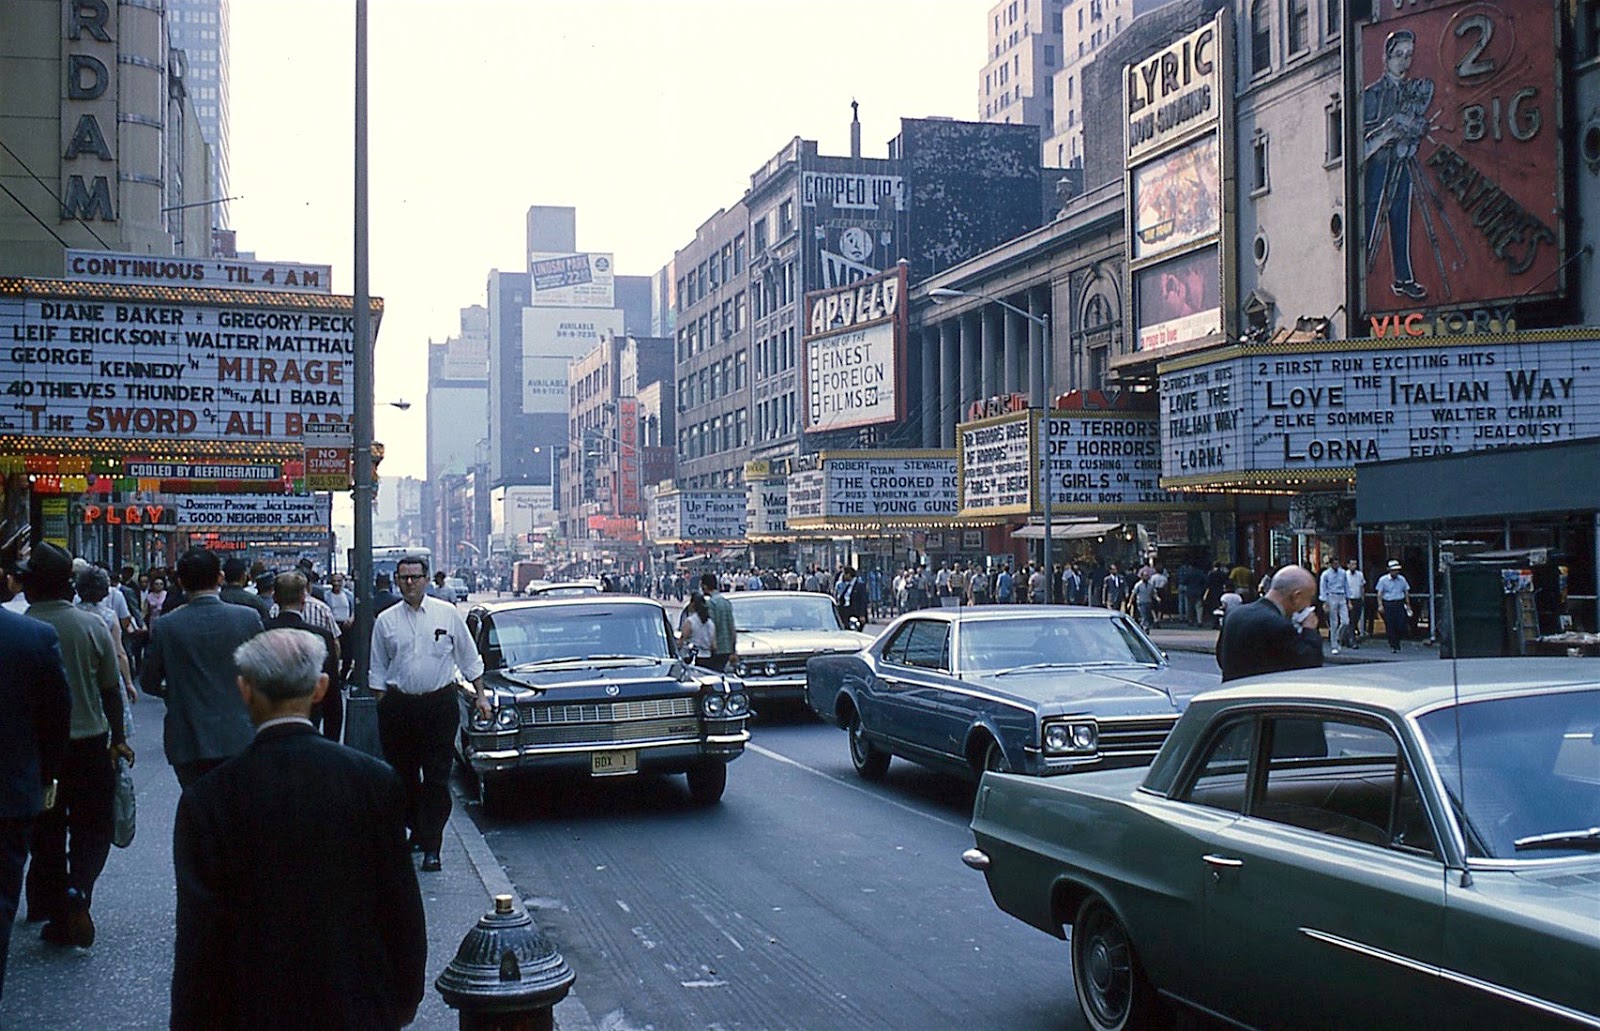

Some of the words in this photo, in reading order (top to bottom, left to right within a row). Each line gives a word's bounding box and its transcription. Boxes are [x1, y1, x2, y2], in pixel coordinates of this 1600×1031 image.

[1454, 14, 1494, 79] 2
[1128, 28, 1213, 115] LYRIC
[1464, 87, 1542, 142] BIG
[72, 257, 205, 281] CONTINUOUS
[262, 268, 276, 286] 4
[41, 302, 104, 321] DIANE
[116, 306, 184, 325] BAKER
[218, 311, 303, 331] GREGORY
[308, 316, 354, 333] PECK
[811, 277, 899, 335] APOLLO
[1369, 305, 1517, 340] VICTORY
[13, 324, 59, 342] LEIF
[70, 327, 166, 346] ERICKSON
[186, 331, 259, 351] WALTER
[266, 336, 354, 354] MATTHAU
[11, 347, 93, 365] GEORGE
[100, 361, 186, 379] KENNEDY
[822, 343, 873, 370] FINEST
[1258, 362, 1268, 376] 2
[1275, 359, 1323, 376] FIRST
[1332, 358, 1363, 373] RUN
[1372, 353, 1449, 371] EXCITING
[1458, 352, 1496, 367] HITS
[823, 362, 884, 392] FOREIGN
[1163, 380, 1169, 392] 2
[7, 380, 34, 397] 40
[37, 382, 116, 399] THIEVES
[124, 383, 214, 403] THUNDER
[251, 388, 281, 404] ALI
[290, 389, 342, 407] BABA
[823, 390, 863, 413] FILMS
[1352, 375, 1382, 390] THE
[1390, 375, 1490, 405] ITALIAN
[86, 405, 197, 434] SWORD
[224, 410, 271, 436] ALI
[1169, 412, 1211, 438] ITALIAN
[1274, 413, 1316, 428] ELKE
[1327, 410, 1395, 427] SOMMER
[1431, 406, 1497, 422] WALTER
[1507, 404, 1563, 420] CHIARI
[309, 459, 347, 468] STANDING
[319, 449, 338, 459] NO
[1079, 459, 1121, 470] CUSHING
[130, 464, 174, 477] COOLED
[177, 465, 190, 477] BY
[194, 465, 275, 479] REFRIGERATION
[831, 461, 870, 471] ROBERT
[870, 466, 895, 476] RYAN
[904, 460, 949, 471] STEWART
[310, 475, 325, 486] BUS
[327, 475, 347, 486] STOP
[870, 476, 934, 489] CROOKED
[1116, 473, 1130, 483] ON
[1134, 479, 1154, 489] THE
[185, 499, 224, 510] DOROTHY
[845, 490, 867, 498] RUSS
[913, 490, 930, 498] AND
[1059, 492, 1092, 502] BEACH
[1098, 492, 1123, 503] BOYS
[84, 504, 164, 524] PLAY
[226, 512, 282, 524] NEIGHBOR
[705, 501, 734, 513] FROM
[873, 500, 917, 513] YOUNG
[594, 756, 613, 768] BDX
